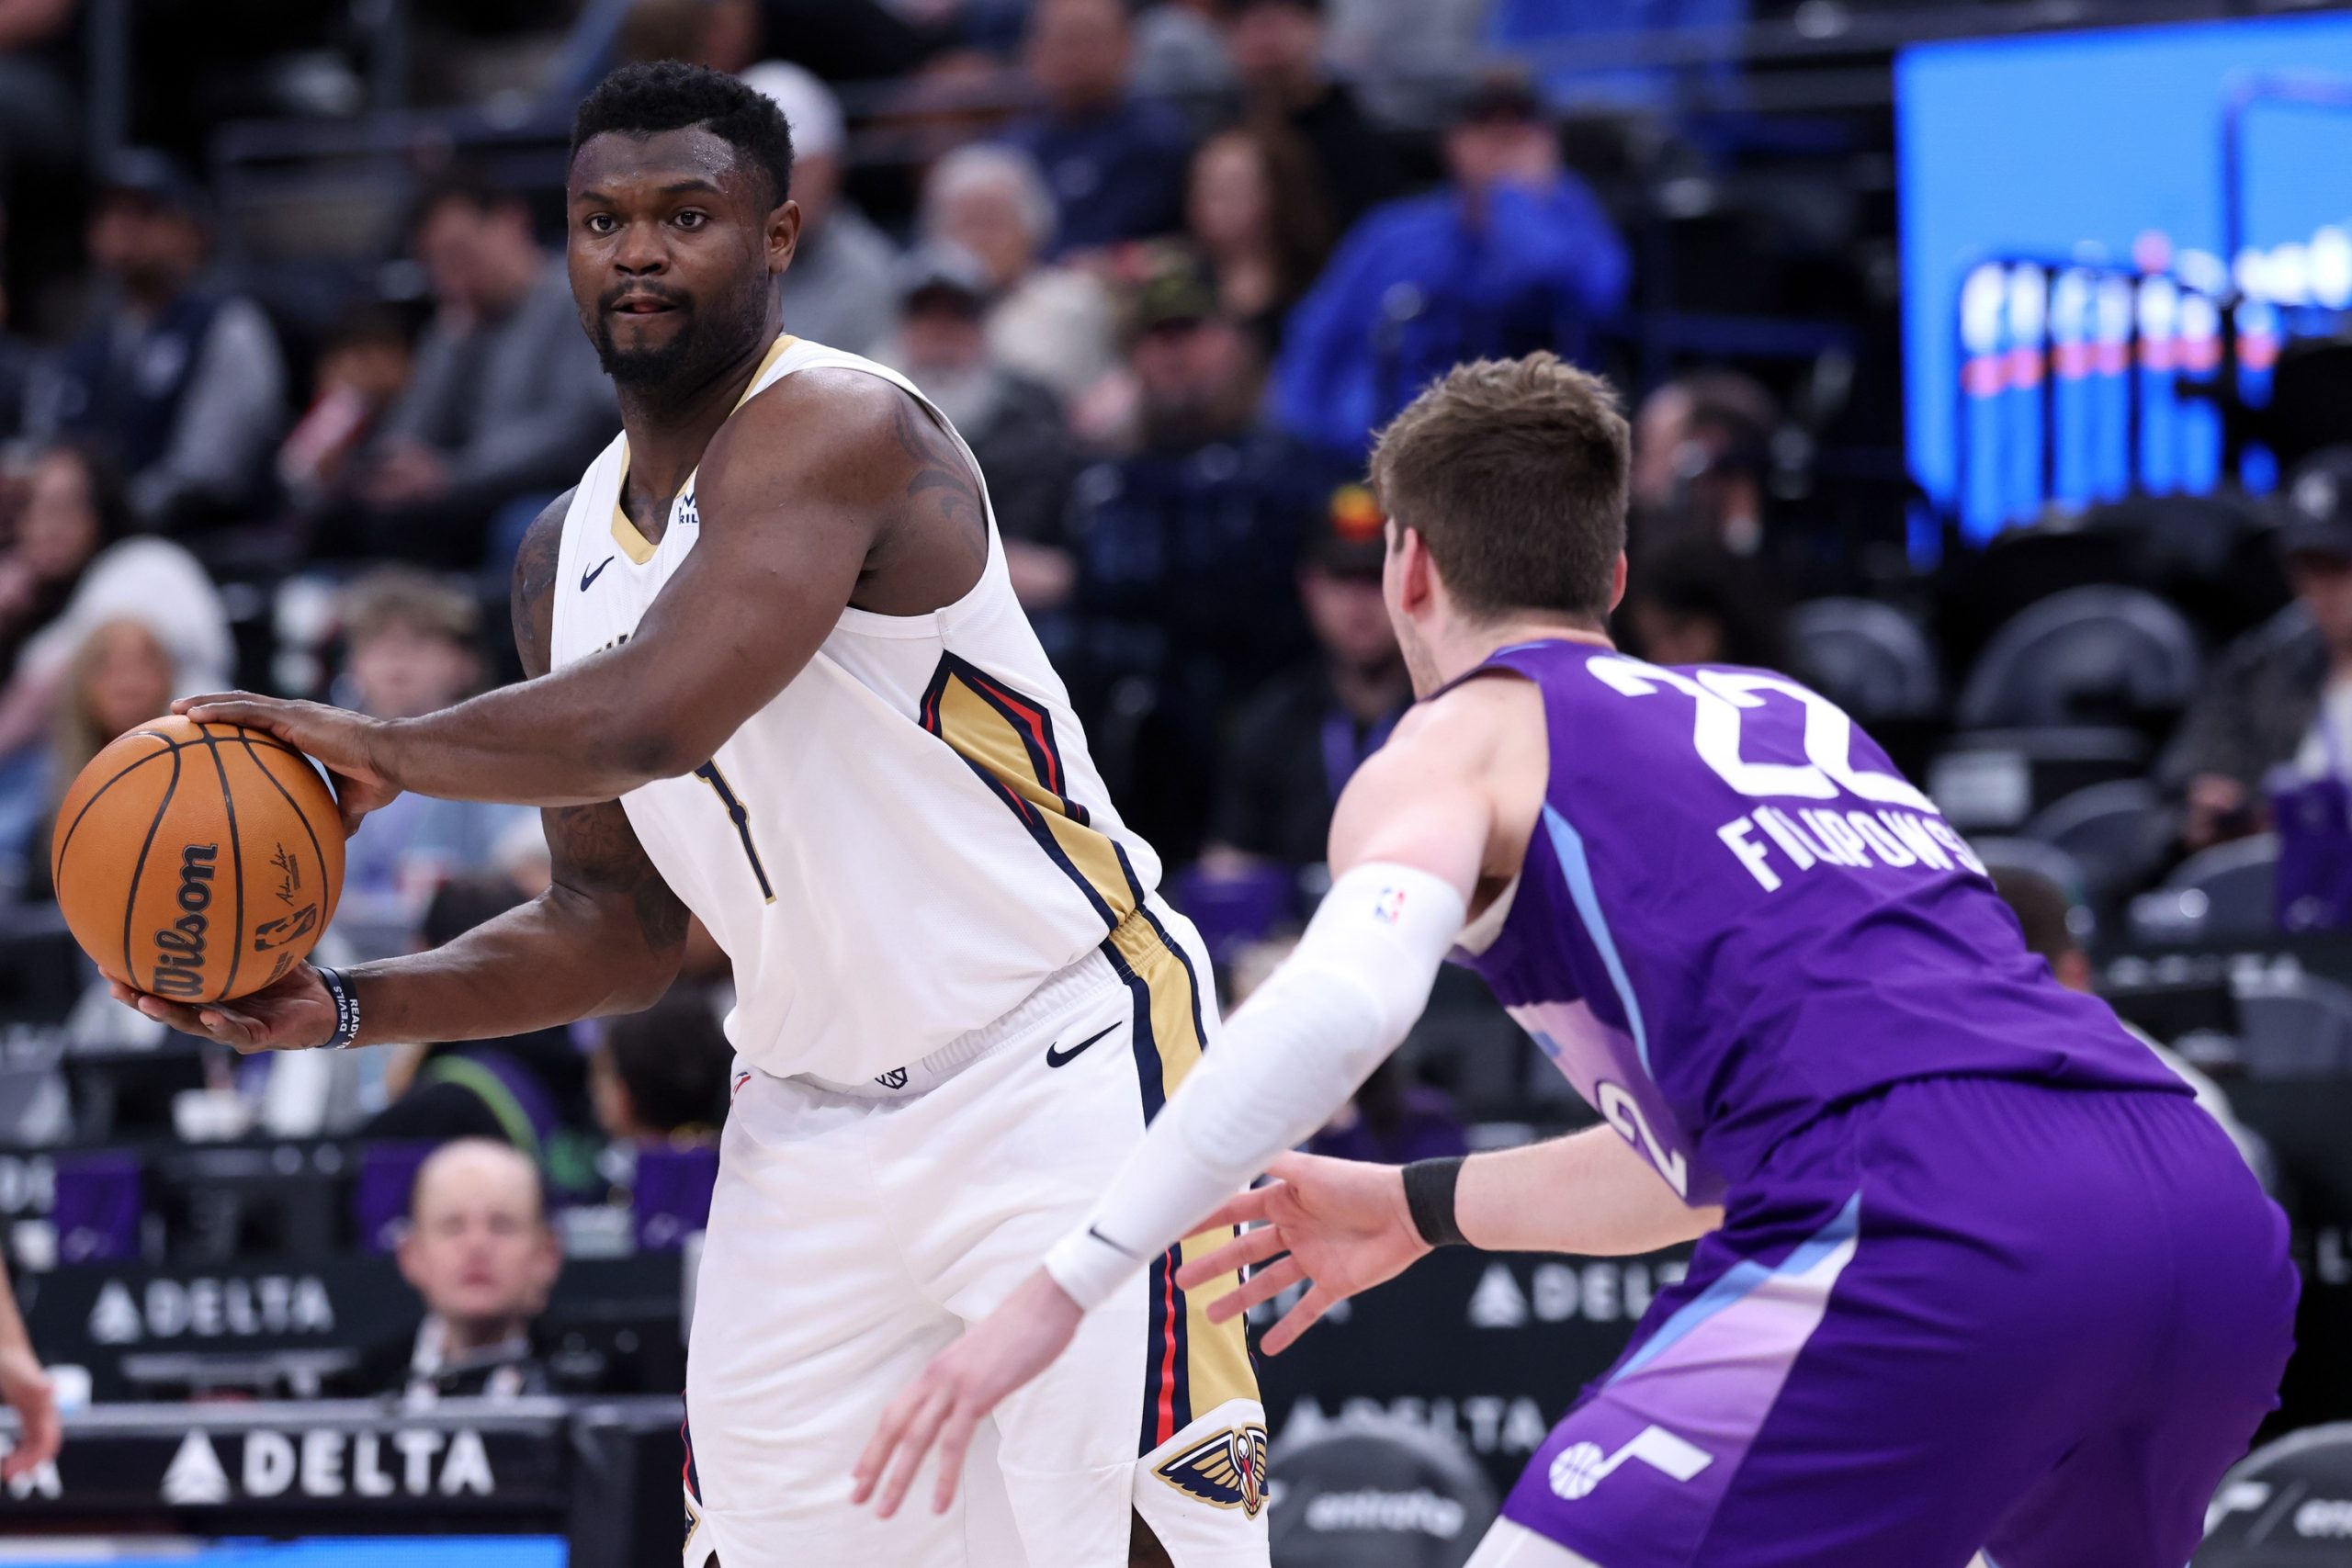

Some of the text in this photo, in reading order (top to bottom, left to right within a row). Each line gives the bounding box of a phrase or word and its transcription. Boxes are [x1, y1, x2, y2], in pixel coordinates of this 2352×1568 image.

[1585, 654, 1940, 817] 22
[692, 756, 777, 906] 1
[1716, 805, 1989, 893] FILIPOWS
[153, 842, 219, 997] Wilson
[333, 986, 349, 1032] D'EVILS
[347, 998, 361, 1040] READY
[143, 1275, 334, 1337] DELTA
[242, 1428, 495, 1497] DELTA
